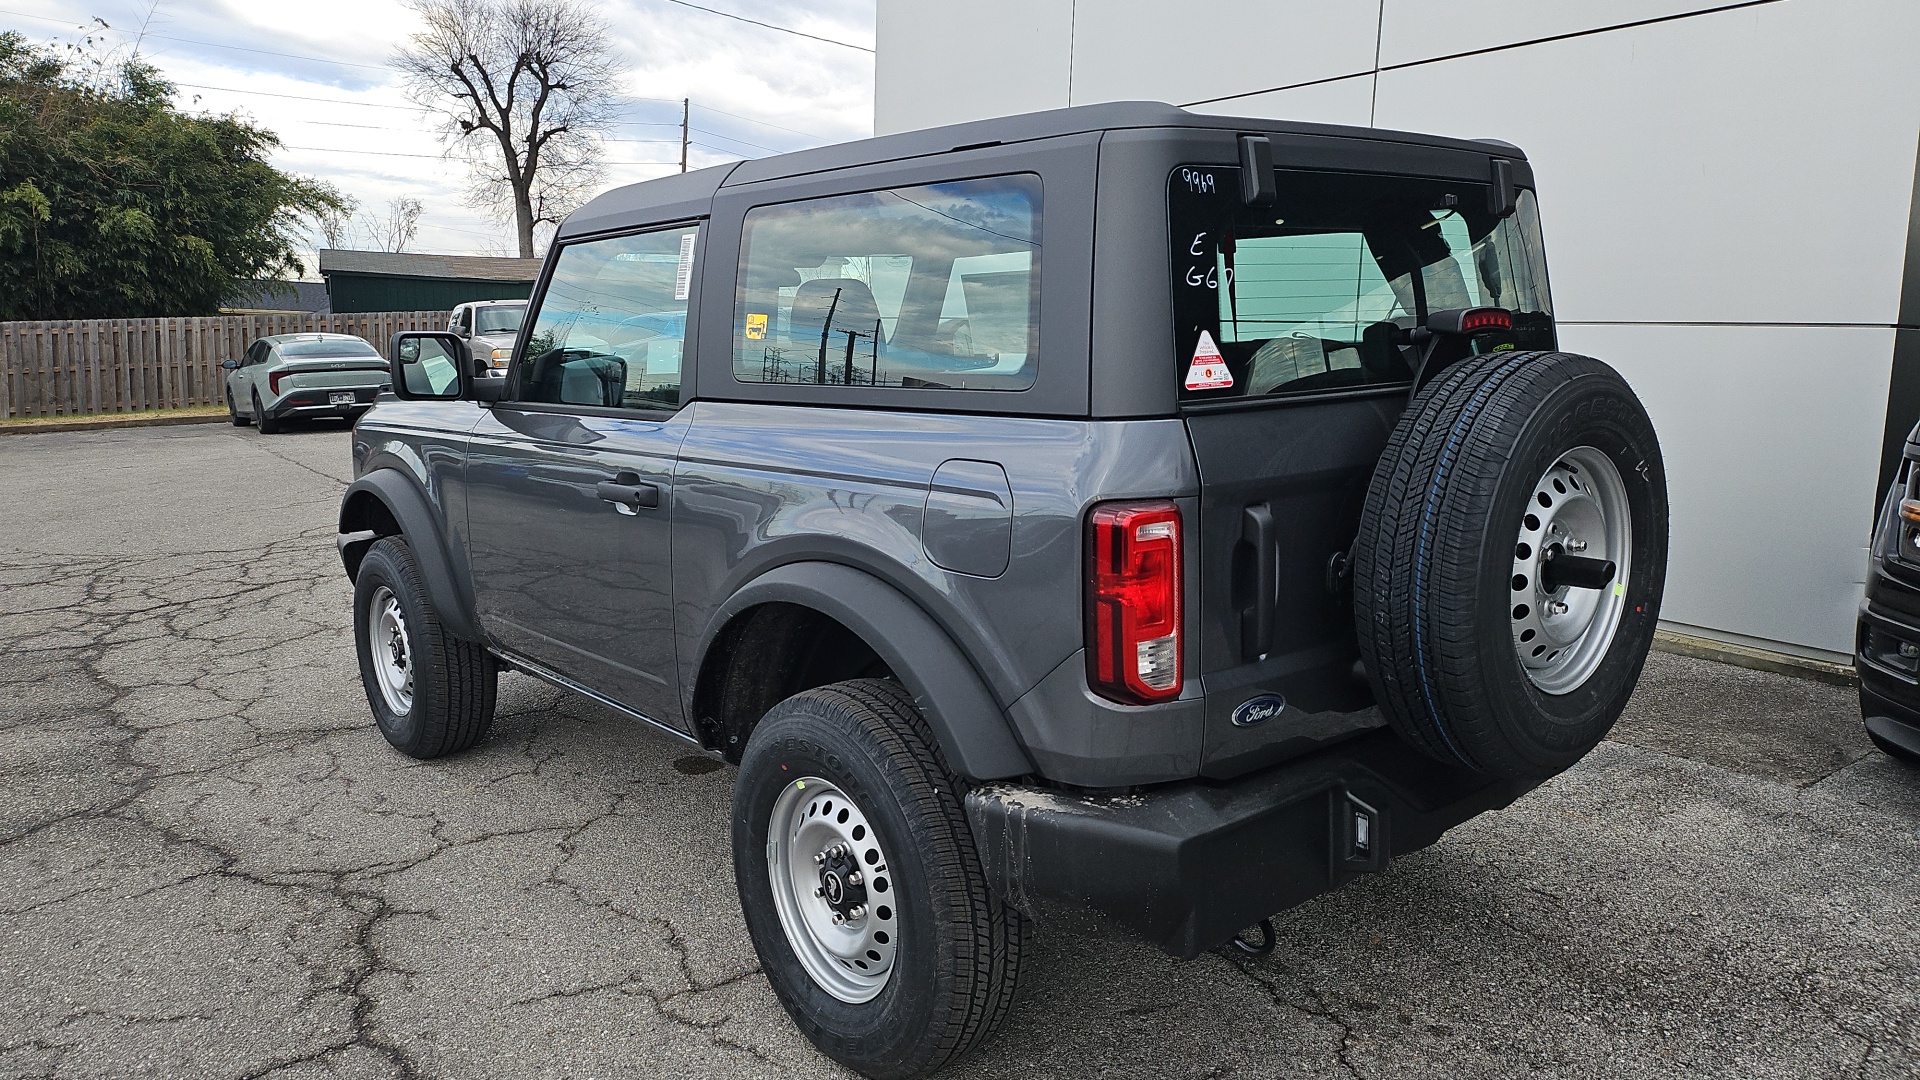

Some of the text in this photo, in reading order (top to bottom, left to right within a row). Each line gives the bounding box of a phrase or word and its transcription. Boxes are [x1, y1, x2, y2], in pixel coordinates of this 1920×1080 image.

[1182, 168, 1216, 194] 9969
[1190, 232, 1207, 255] E
[1246, 702, 1274, 722] Ford
